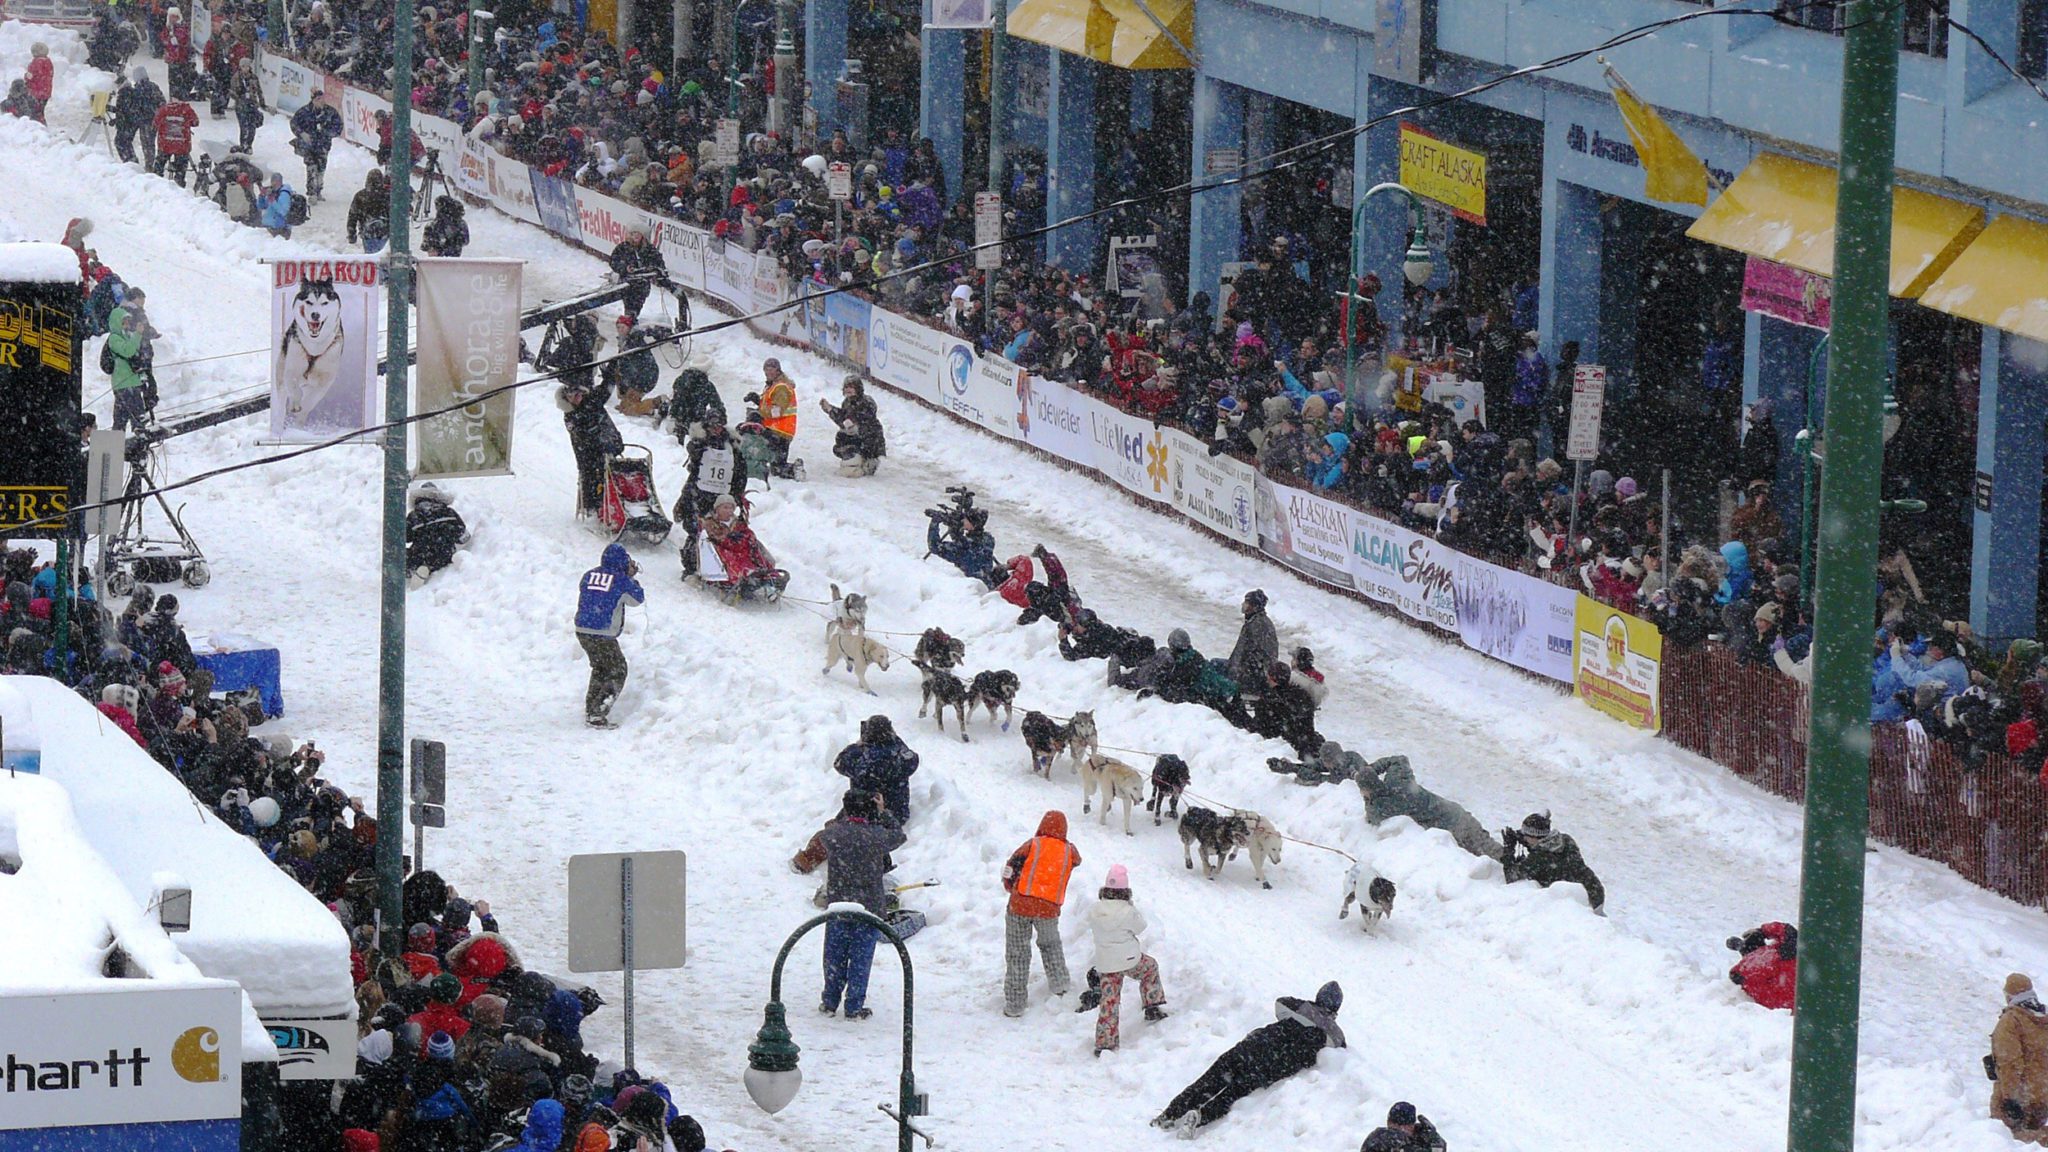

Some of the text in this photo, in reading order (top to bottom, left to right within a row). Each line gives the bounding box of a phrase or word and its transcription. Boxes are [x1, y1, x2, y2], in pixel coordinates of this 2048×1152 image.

[1401, 139, 1484, 190] CRAFT ALASKA
[664, 223, 700, 250] HORIZON
[275, 261, 377, 288] IDITAROD
[453, 274, 494, 465] anchorage
[1032, 390, 1081, 435] Tidewater
[1091, 411, 1143, 465] LifeMed
[710, 467, 725, 480] 18
[1289, 495, 1350, 551] ALASKAN
[1317, 545, 1345, 566] Sponsor
[1354, 529, 1453, 600] ALCAN Signs
[587, 572, 614, 591] ny
[0, 1047, 150, 1092] hartt
